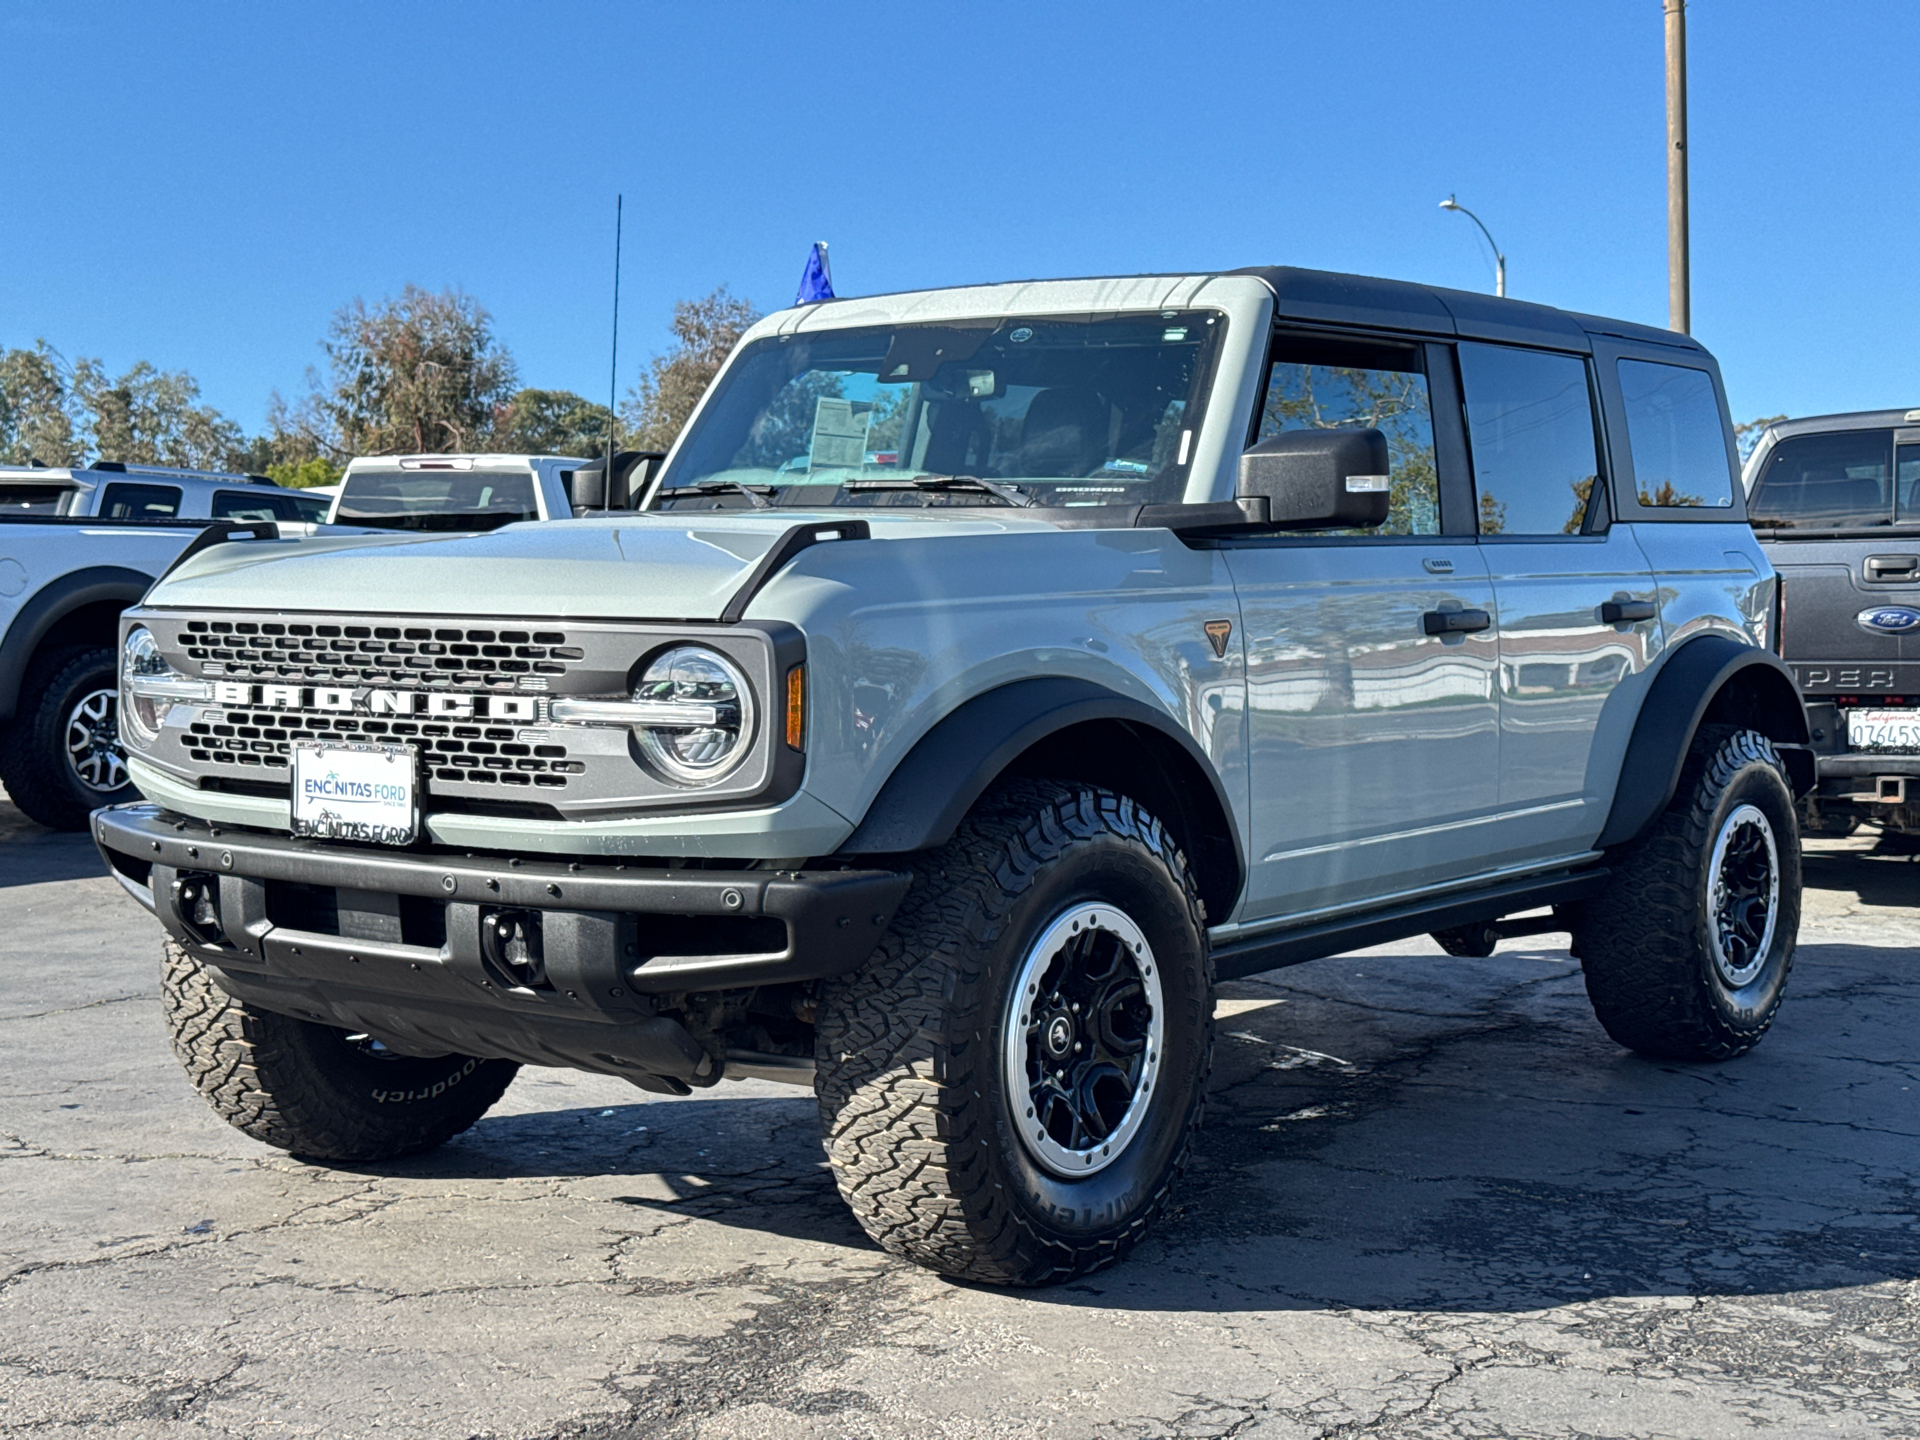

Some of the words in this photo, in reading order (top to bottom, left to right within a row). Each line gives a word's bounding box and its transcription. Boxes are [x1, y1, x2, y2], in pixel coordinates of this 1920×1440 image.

[1877, 613, 1909, 625] Ford
[1794, 667, 1895, 688] PER
[214, 681, 538, 721] BRONCO
[1865, 712, 1915, 724] California
[305, 777, 372, 798] ENCINITAS
[375, 784, 406, 801] FORD
[296, 818, 370, 840] ENCINITAS
[372, 824, 411, 844] FORD
[371, 1057, 487, 1104] oodrich
